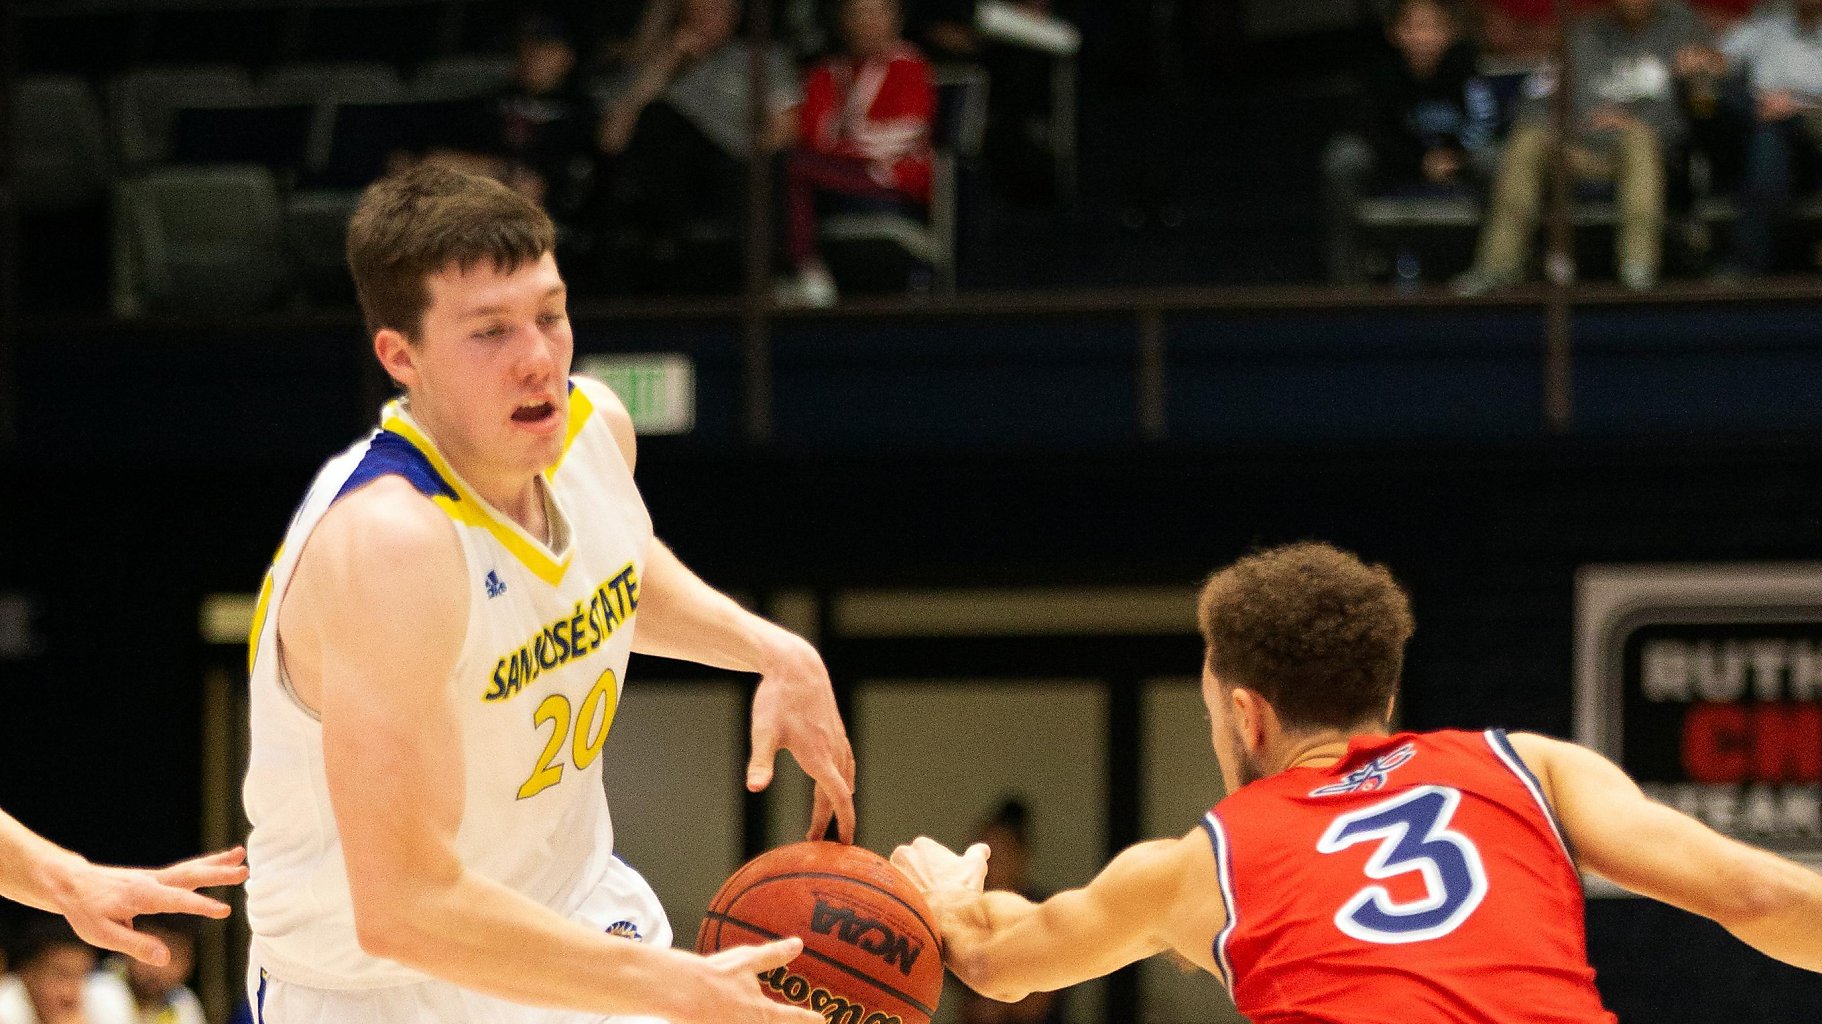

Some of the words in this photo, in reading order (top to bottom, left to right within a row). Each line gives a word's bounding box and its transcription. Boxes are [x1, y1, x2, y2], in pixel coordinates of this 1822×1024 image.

[484, 644, 532, 701] SAN
[532, 602, 588, 680] JOSÉ
[588, 563, 639, 650] SATE
[516, 668, 618, 800] 20
[1316, 784, 1489, 944] 3
[811, 899, 926, 977] NCAA
